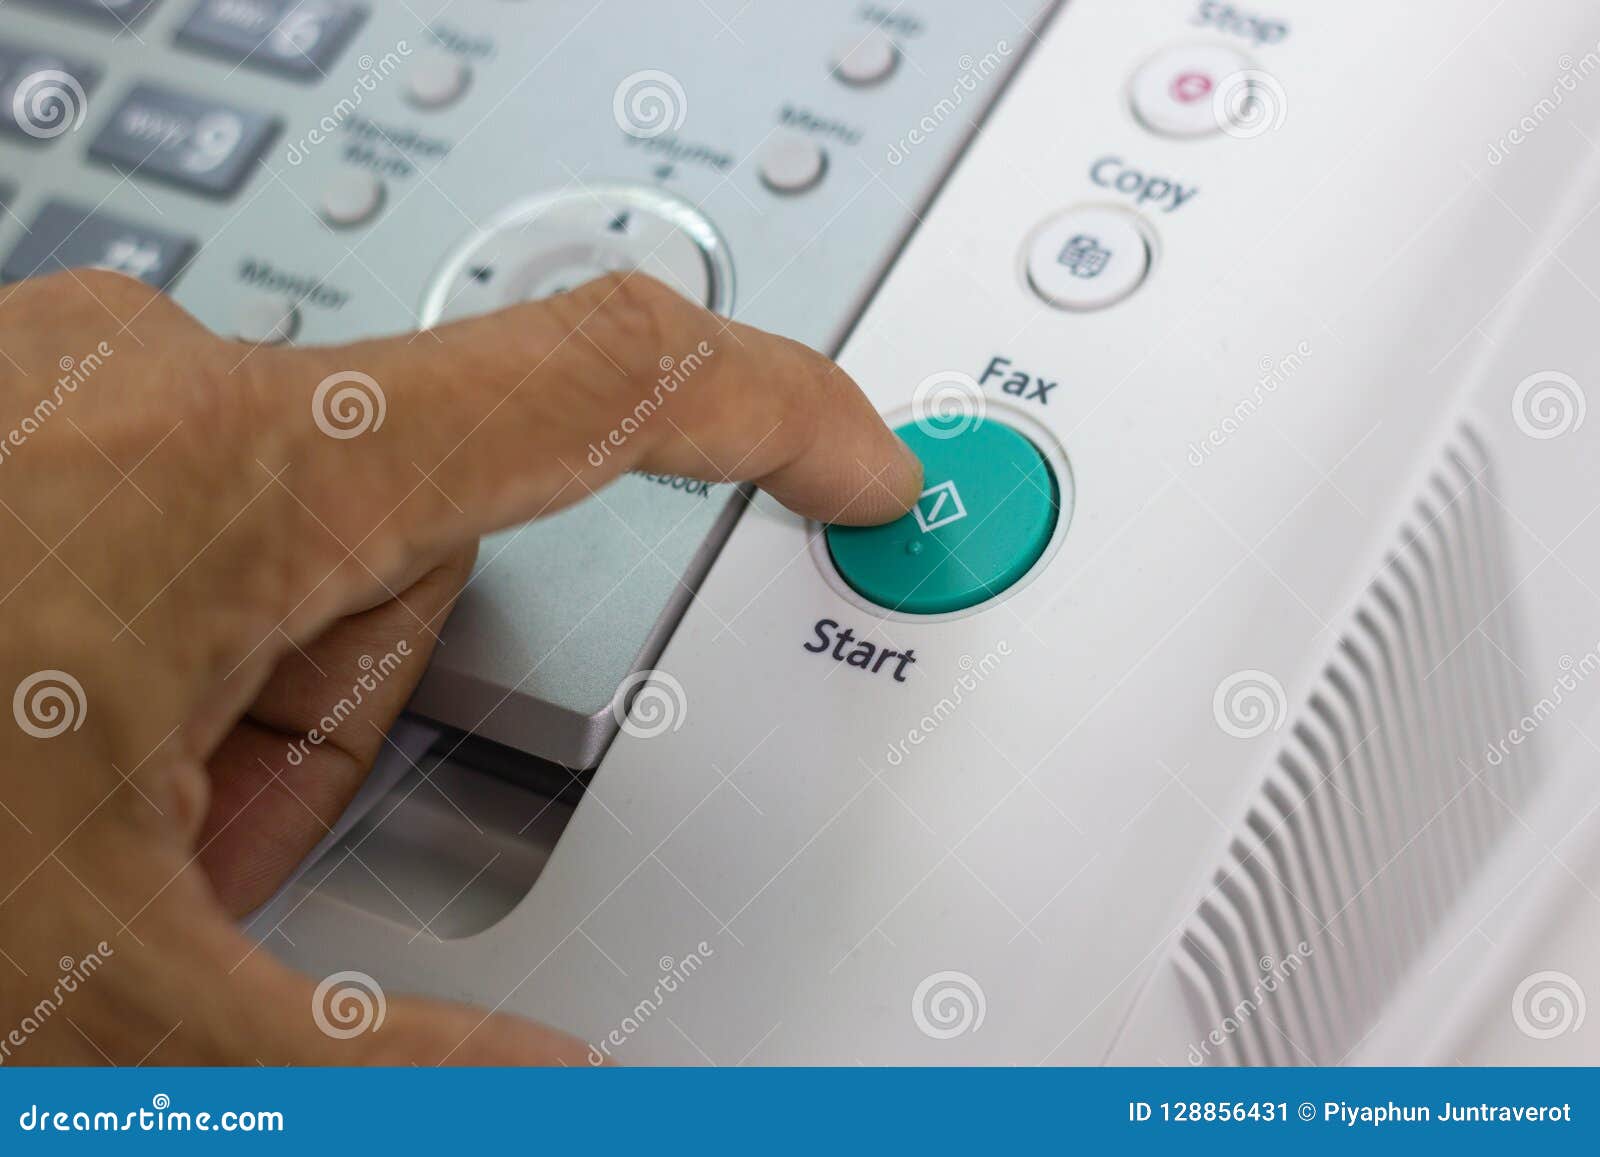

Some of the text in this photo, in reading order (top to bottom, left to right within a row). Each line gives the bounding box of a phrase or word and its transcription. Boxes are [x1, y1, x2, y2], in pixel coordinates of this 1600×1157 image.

[1190, 0, 1289, 46] Stop
[184, 111, 243, 174] 9
[1089, 156, 1199, 213] Copy
[239, 259, 349, 310] Monitor
[978, 356, 1058, 406] Fax
[803, 618, 917, 683] Start
